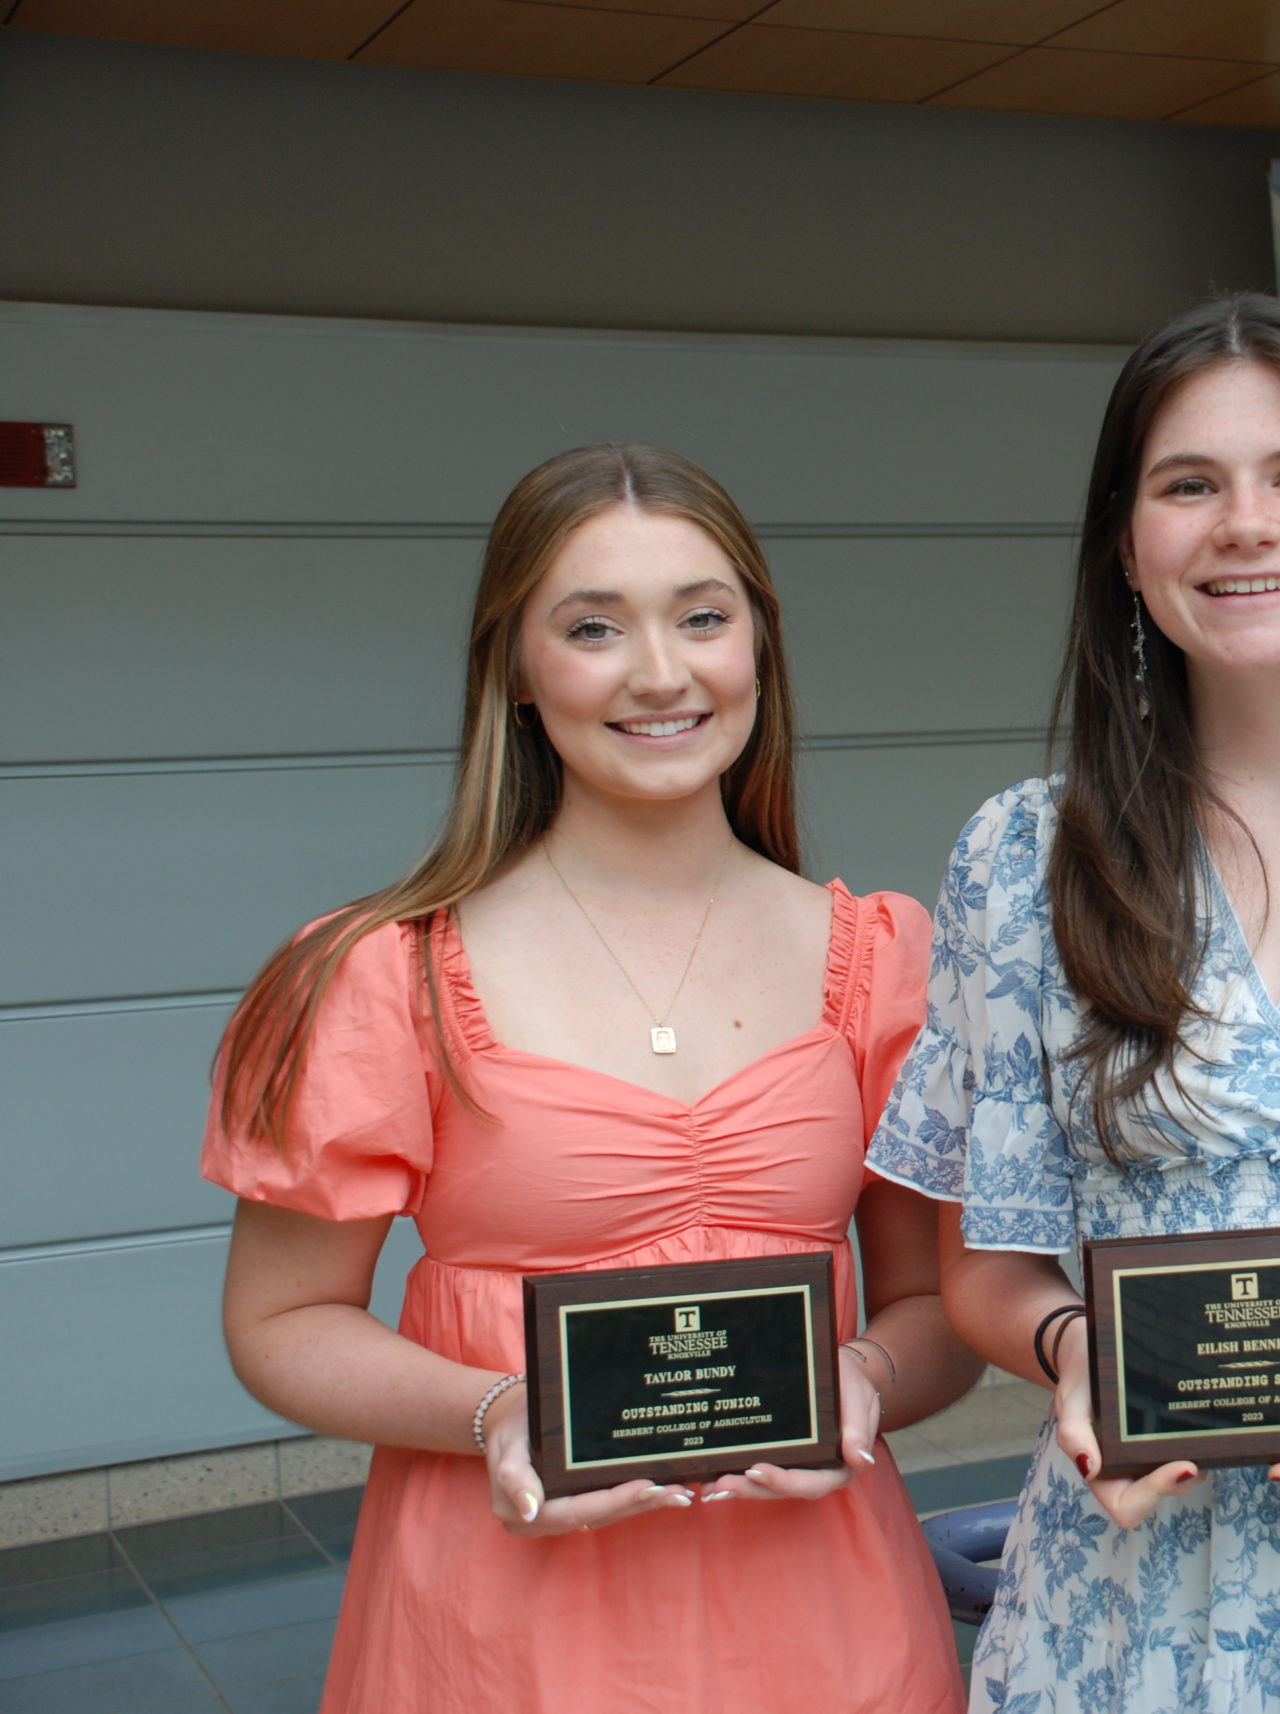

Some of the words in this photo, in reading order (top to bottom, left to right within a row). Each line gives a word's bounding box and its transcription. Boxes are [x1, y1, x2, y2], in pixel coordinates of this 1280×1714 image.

[1235, 1277, 1253, 1295] T
[1205, 1302, 1222, 1311] THE
[1223, 1300, 1274, 1310] UNIVERSITY
[678, 1311, 697, 1328] T
[1224, 1319, 1271, 1329] KNOXVILLE
[649, 1335, 665, 1343] THE
[667, 1331, 715, 1342] UNIVERSITY
[716, 1330, 727, 1338] OF
[649, 1336, 728, 1355] TENNESSEE
[1197, 1340, 1239, 1355] EILISH
[667, 1350, 711, 1360] KNOXVILLE
[644, 1370, 692, 1385] TAYLOR
[695, 1365, 736, 1380] BUNDY
[1177, 1374, 1269, 1392] OUTSTANDING
[622, 1401, 709, 1420] OUTSTANDING
[714, 1396, 761, 1412] JUNIOR
[1168, 1399, 1211, 1410] HERBERT
[1213, 1396, 1255, 1407] COLLEGE
[1258, 1394, 1271, 1404] OF
[1242, 1412, 1264, 1422] 2023
[612, 1426, 654, 1438] HERBERT
[656, 1422, 697, 1434] COLLEGE
[699, 1420, 712, 1430] OF
[714, 1414, 772, 1428] AGRICULTURE
[683, 1437, 704, 1447] 2023
